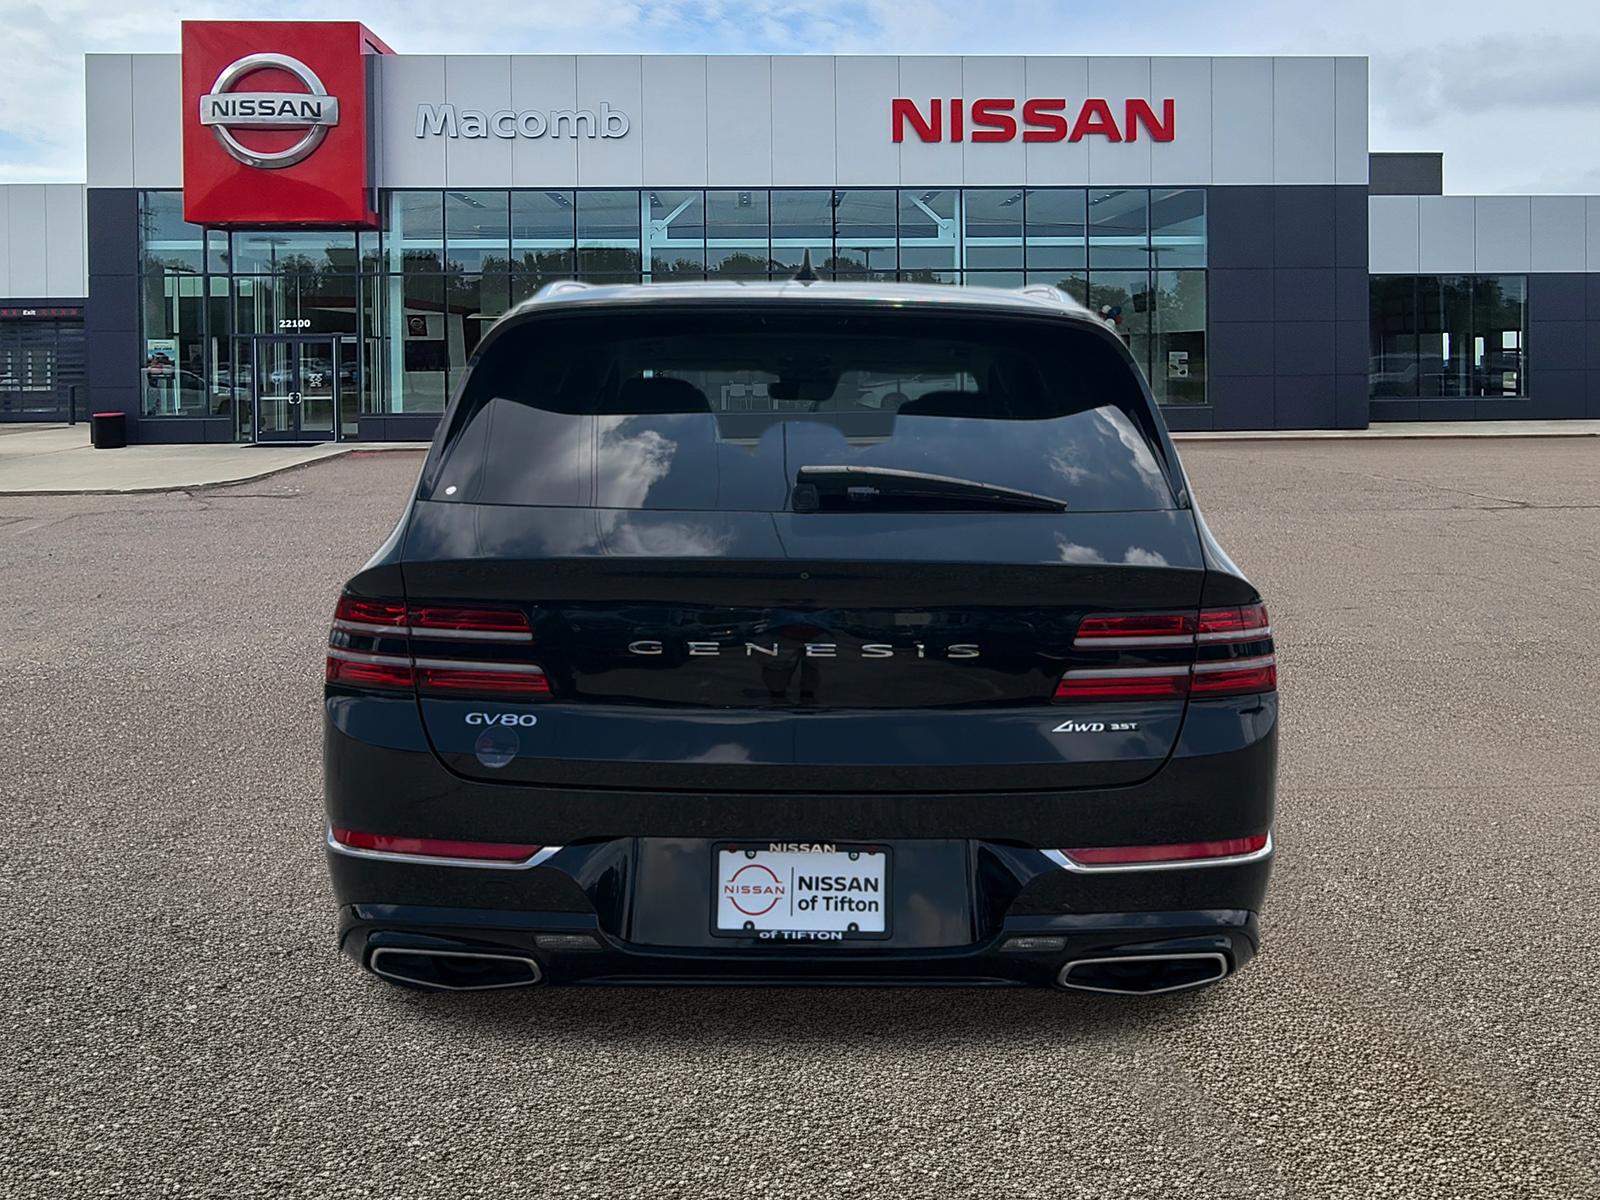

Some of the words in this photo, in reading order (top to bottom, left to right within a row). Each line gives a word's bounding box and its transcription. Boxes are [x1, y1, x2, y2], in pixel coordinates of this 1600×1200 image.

[211, 99, 322, 118] NISSAN
[415, 102, 631, 140] Macomb
[892, 98, 1175, 143] NISSAN
[279, 319, 311, 328] 22100
[628, 640, 981, 659] GENESIS
[464, 712, 538, 727] GV80
[769, 843, 836, 853] NISSAN
[724, 885, 785, 895] NISSAN
[798, 876, 879, 892] NISSAN
[798, 896, 818, 911] of
[822, 896, 879, 912] Tifton
[759, 930, 778, 939] of
[781, 931, 843, 941] TIFTON
